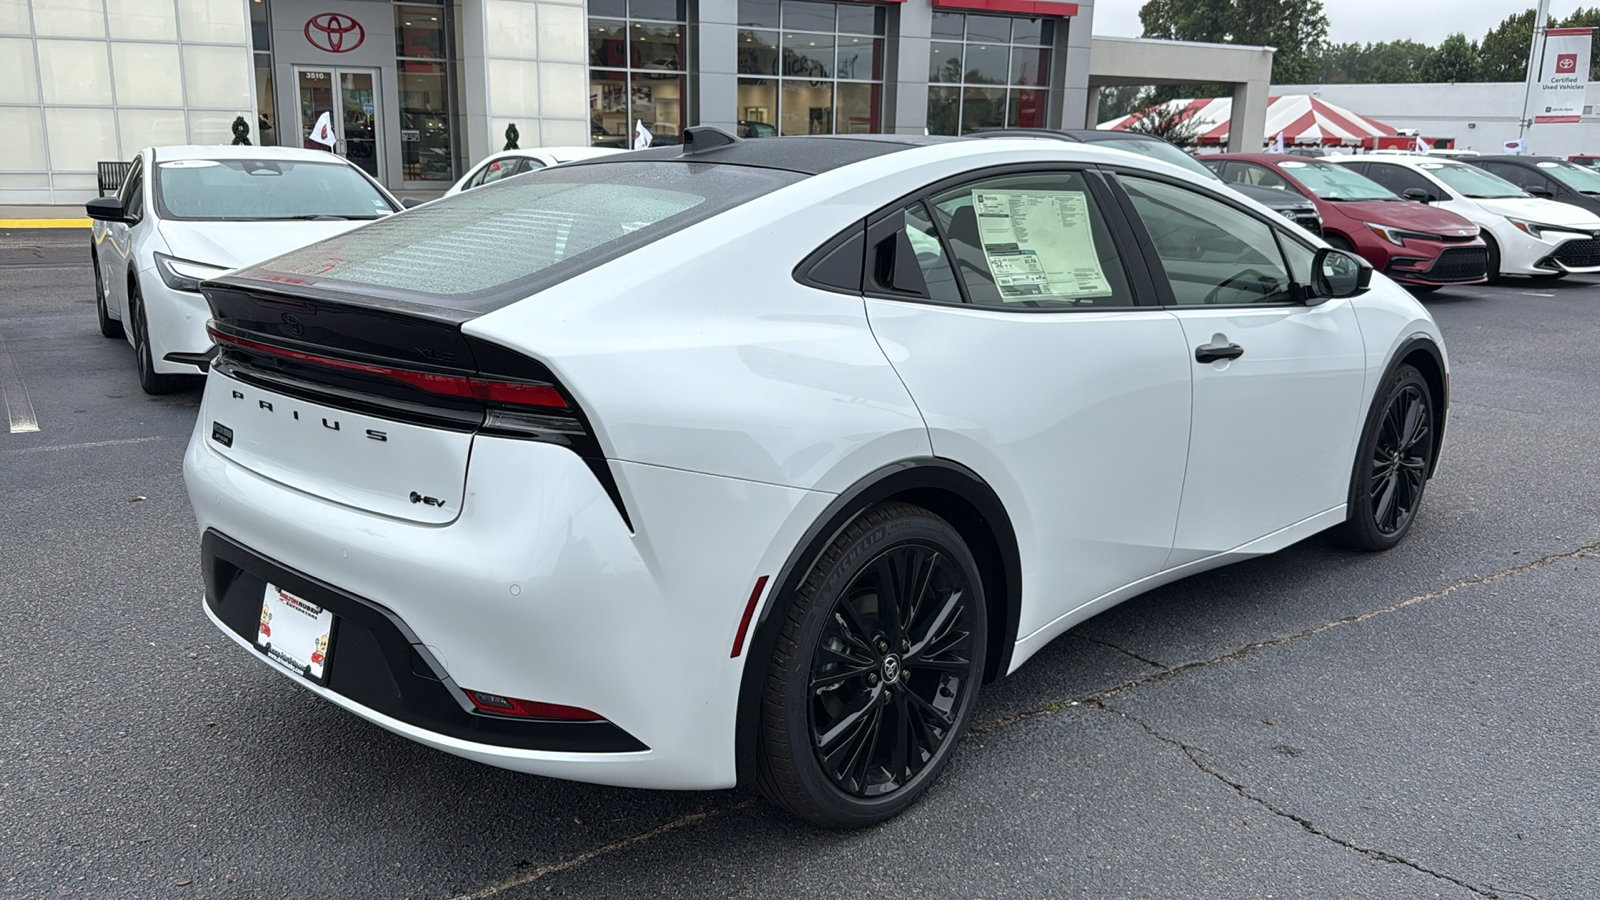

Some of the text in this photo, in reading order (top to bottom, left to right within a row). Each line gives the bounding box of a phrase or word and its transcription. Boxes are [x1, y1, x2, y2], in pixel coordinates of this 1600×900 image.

[993, 260, 1004, 268] 52
[413, 346, 458, 363] XLE
[231, 390, 388, 442] PRIUS
[418, 494, 446, 507] HEV
[829, 529, 884, 589] MICHELIN
[286, 602, 318, 620] SUPERSTORE
[298, 602, 319, 615] RUBEN
